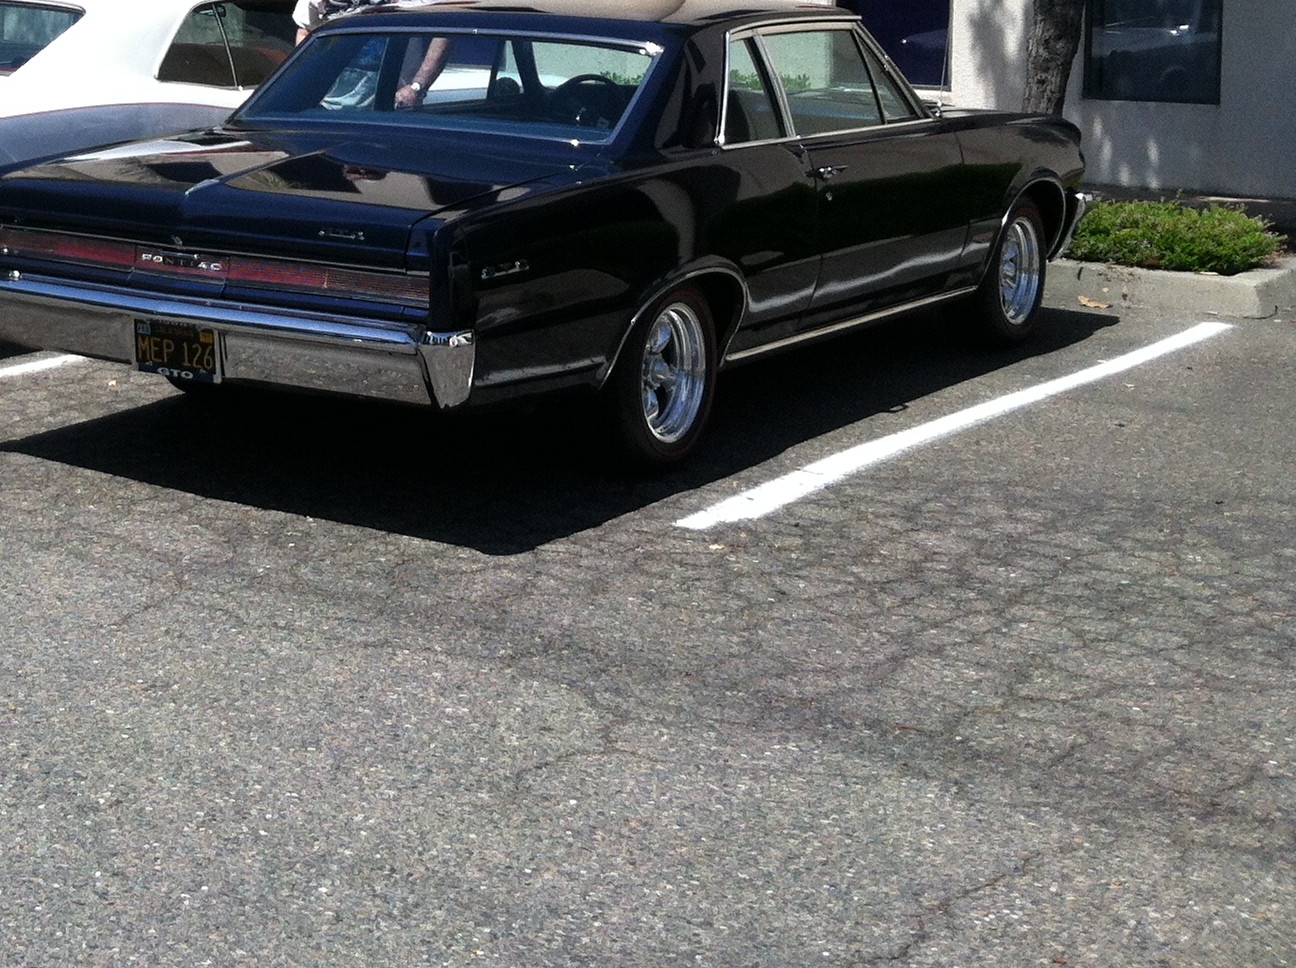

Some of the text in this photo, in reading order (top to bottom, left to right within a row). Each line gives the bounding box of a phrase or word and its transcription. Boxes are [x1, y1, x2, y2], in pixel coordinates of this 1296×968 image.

[140, 252, 223, 272] PONTIAC
[137, 335, 214, 370] MEP 126
[157, 367, 194, 379] GTO
